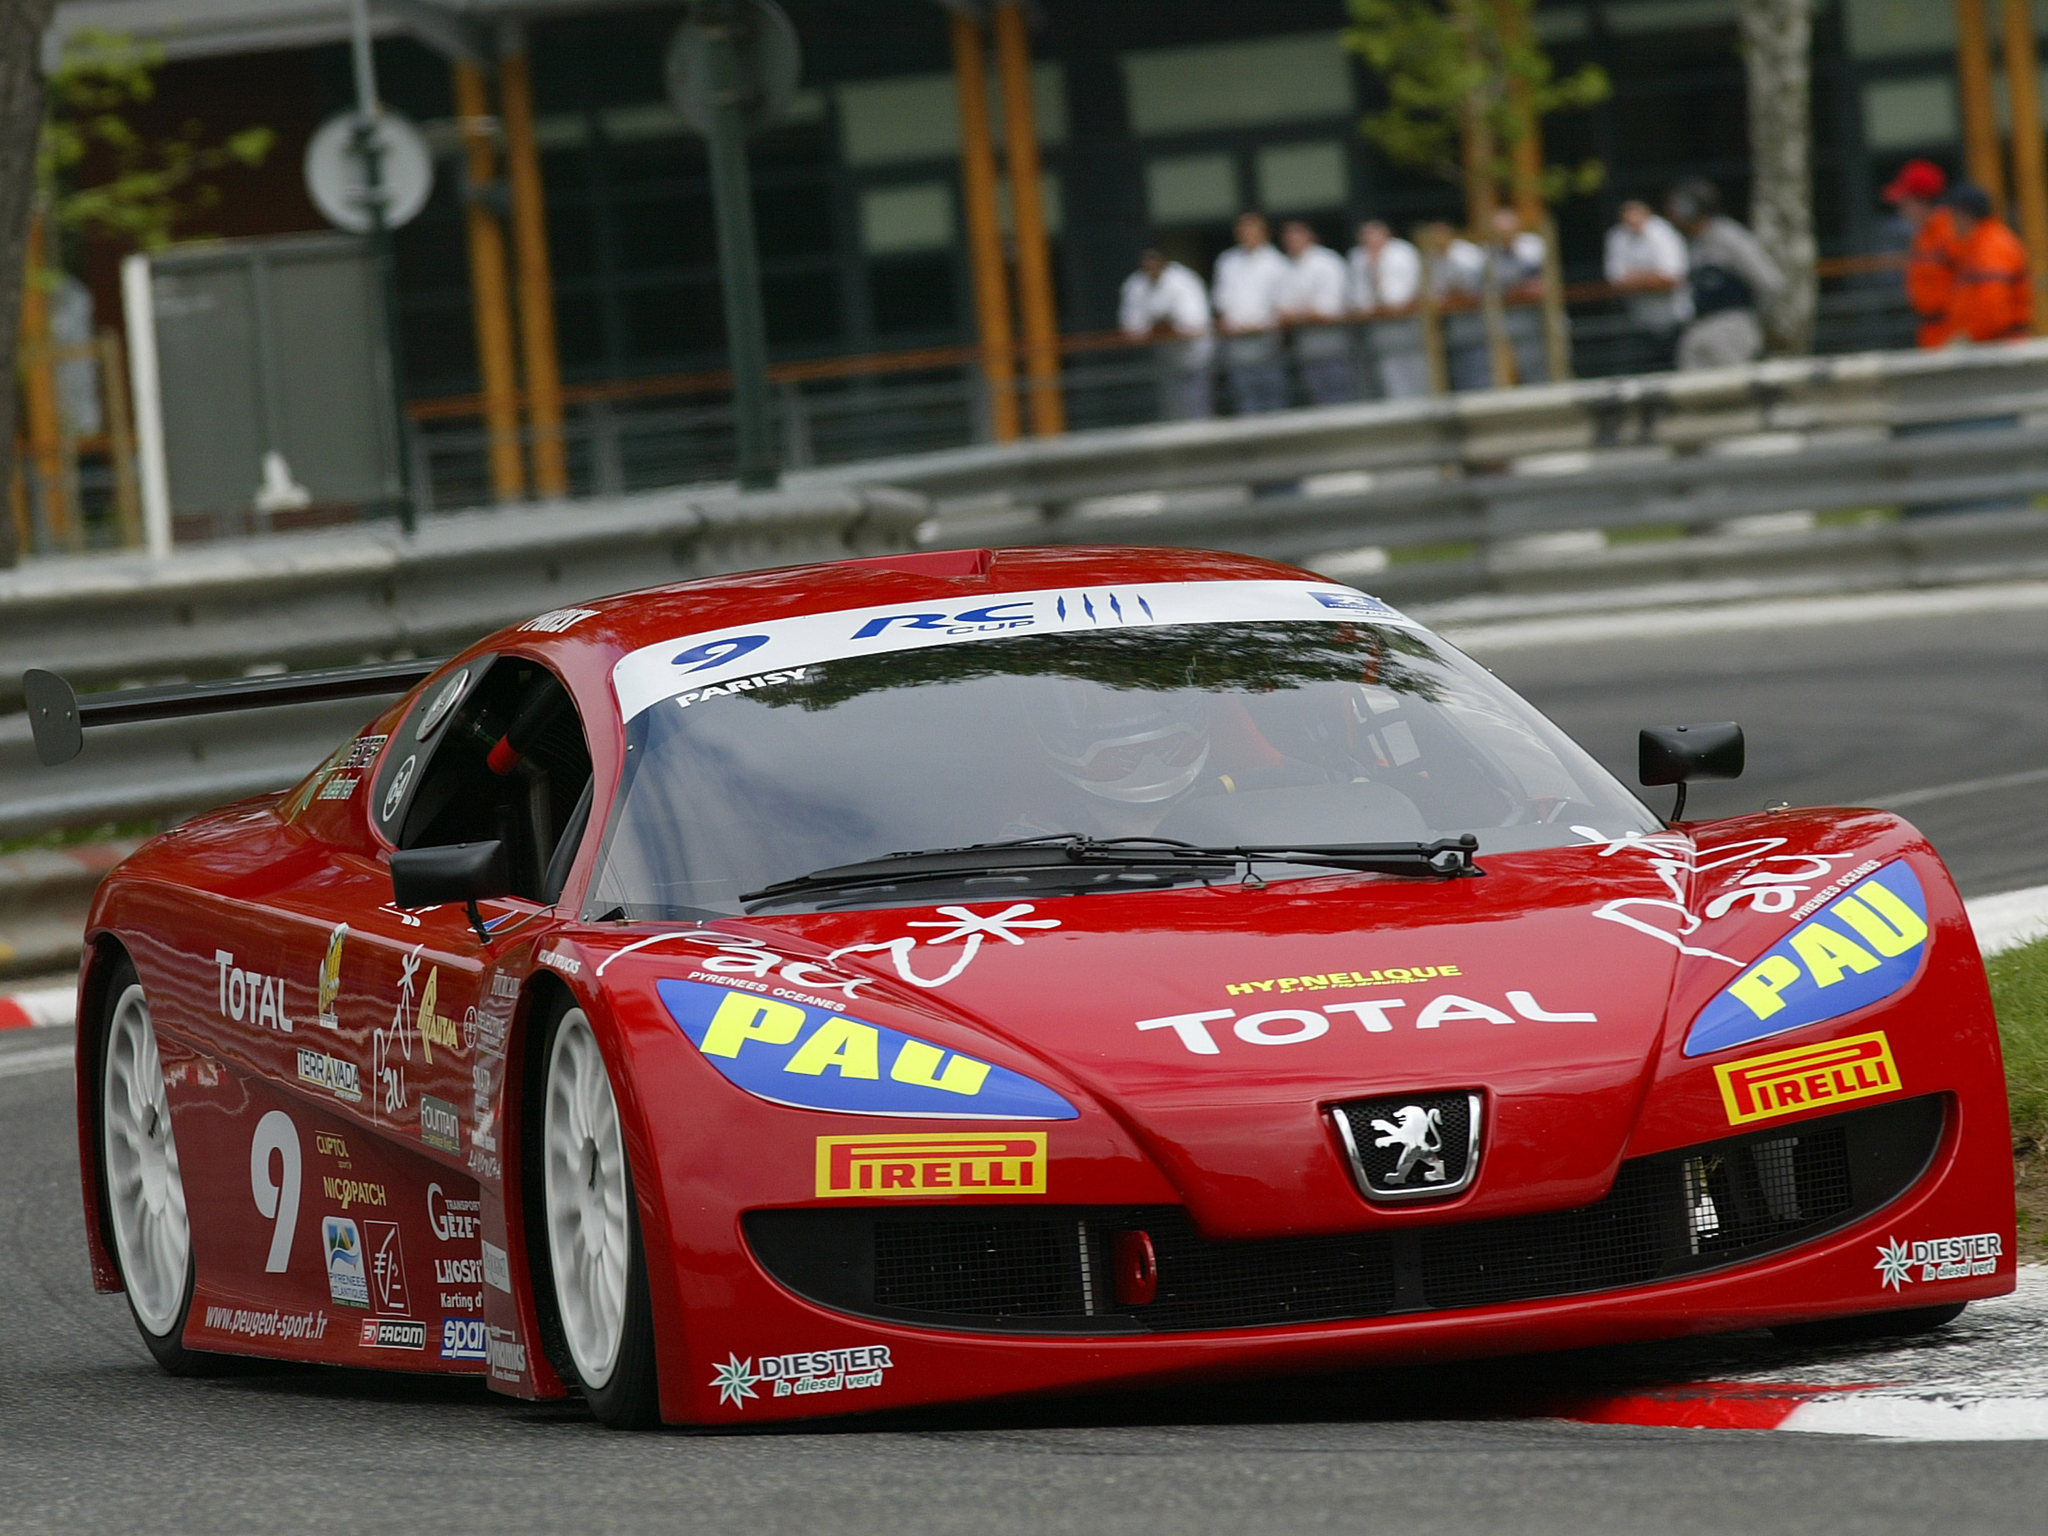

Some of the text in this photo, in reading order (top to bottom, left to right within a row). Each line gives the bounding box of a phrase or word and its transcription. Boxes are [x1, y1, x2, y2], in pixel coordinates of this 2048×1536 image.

[850, 602, 1034, 640] RC
[946, 619, 1035, 636] CUP
[671, 634, 770, 676] 9
[675, 667, 807, 709] PARISY
[1789, 859, 1883, 922] PYRENEES OCEANES
[1728, 880, 1928, 1021] PAU
[216, 948, 293, 1033] TOTAL
[688, 971, 847, 1013] PYRENEES OCEANES
[1226, 964, 1463, 996] HYPNELIQUE
[1135, 990, 1599, 1055] TOTAL
[700, 991, 992, 1096] PAU
[298, 1050, 362, 1092] TERRAVADA
[1729, 1039, 1891, 1117] PIRELLI
[829, 1139, 1037, 1191] PIRELLI
[250, 1110, 302, 1273] 9
[323, 1176, 387, 1210] NICOPATCH
[1913, 1235, 2002, 1263] DIESTER
[1923, 1258, 1996, 1280] le diesel vert
[440, 1291, 473, 1312] Karting
[205, 1305, 328, 1341] www.peugeot-sport.fr
[378, 1325, 424, 1345] FACOM
[443, 1320, 486, 1359] spar
[761, 1346, 892, 1379] DIESTER
[775, 1371, 881, 1395] le diesel vert
